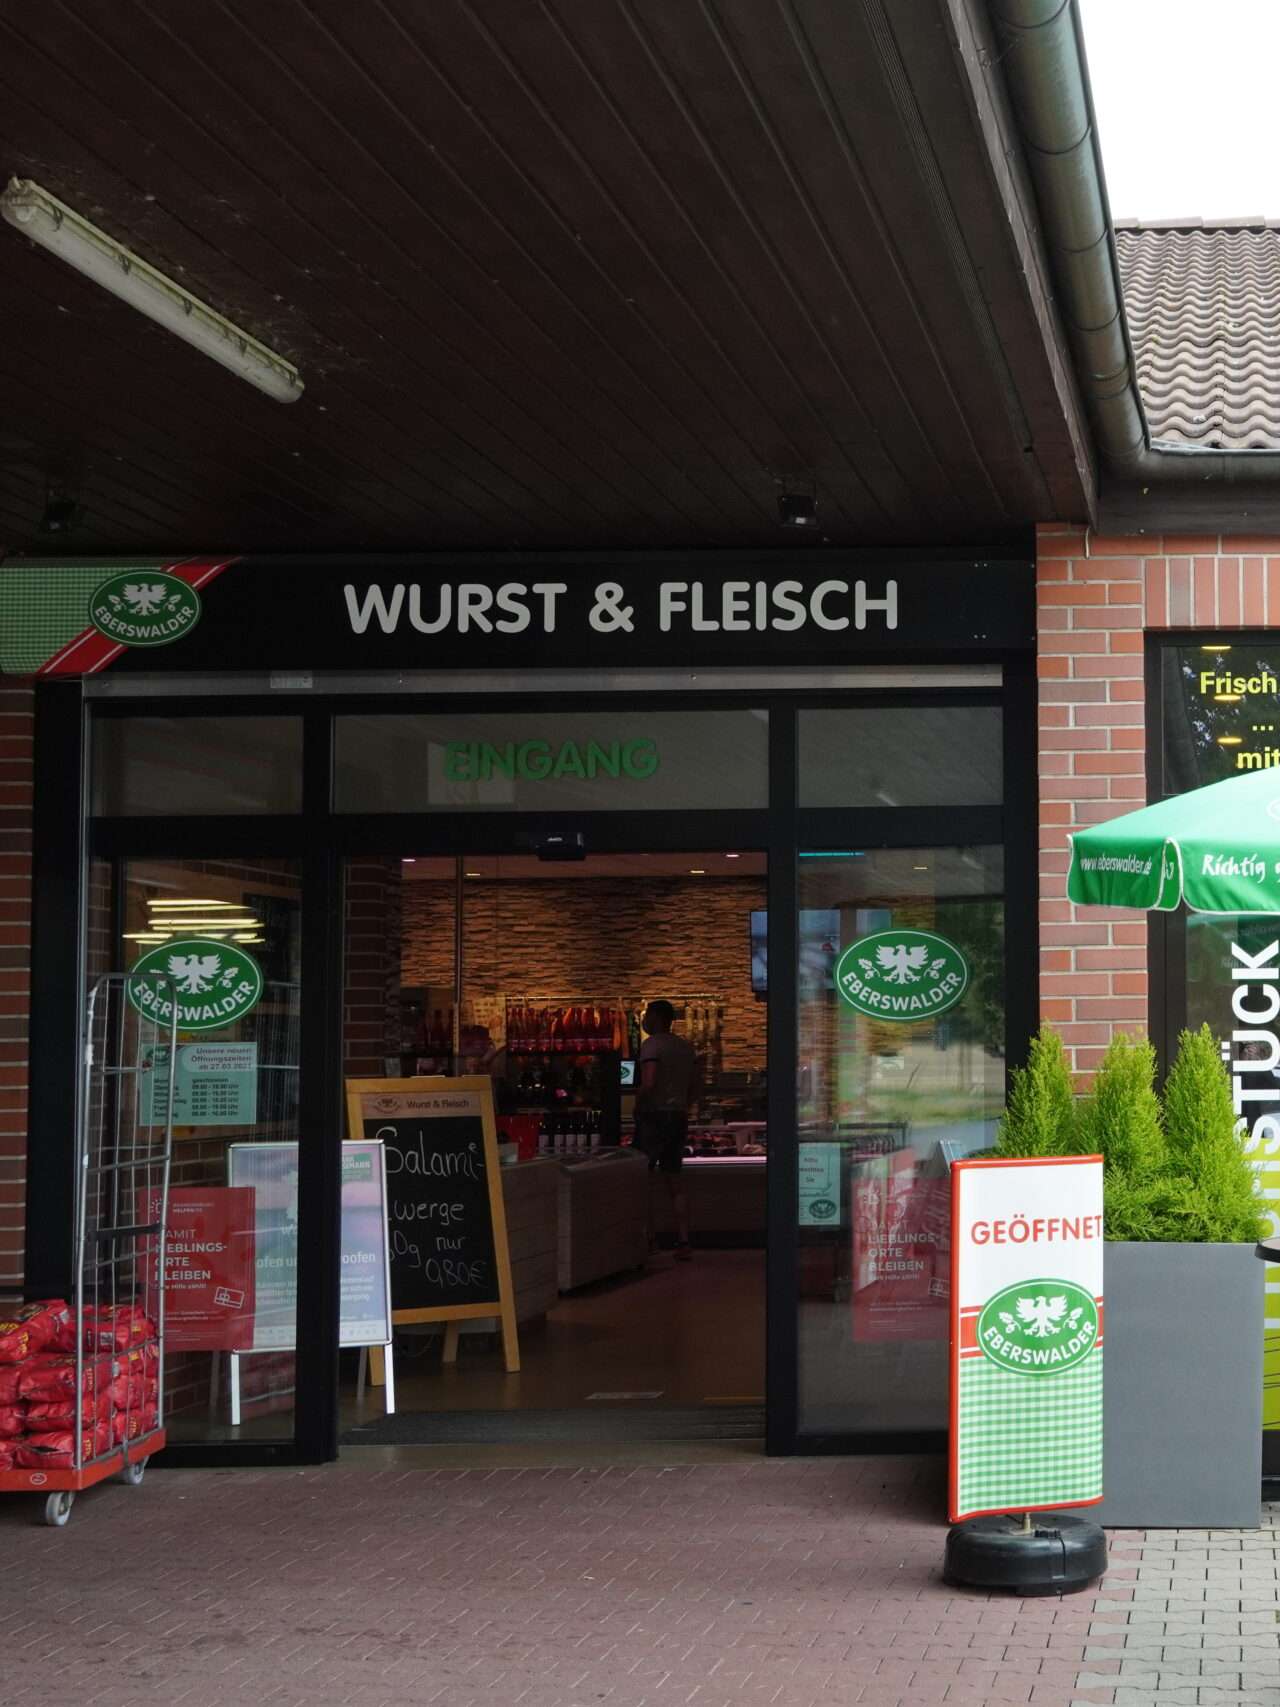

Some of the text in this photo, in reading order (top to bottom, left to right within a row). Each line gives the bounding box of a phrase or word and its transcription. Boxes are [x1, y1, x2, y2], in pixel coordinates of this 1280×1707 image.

[95, 604, 195, 639] EBERSWALDER
[343, 579, 899, 634] WURST & FLEISCH
[446, 738, 659, 782] EINGANG
[1202, 853, 1266, 883] Richtig
[133, 980, 255, 1022] EBERSWALDER
[842, 971, 962, 1011] EBERSWALDER
[406, 1099, 431, 1110] Wurst
[387, 1201, 465, 1226] werge
[157, 1228, 197, 1240] AMIT
[436, 1235, 467, 1252] nur
[971, 1213, 1102, 1245] GEÖFFNET
[155, 1243, 228, 1254] LEBLINGS-
[868, 1247, 903, 1258] ORTE
[869, 1260, 924, 1272] BLEIBEN
[982, 1318, 1096, 1366] EBERSWALDER
